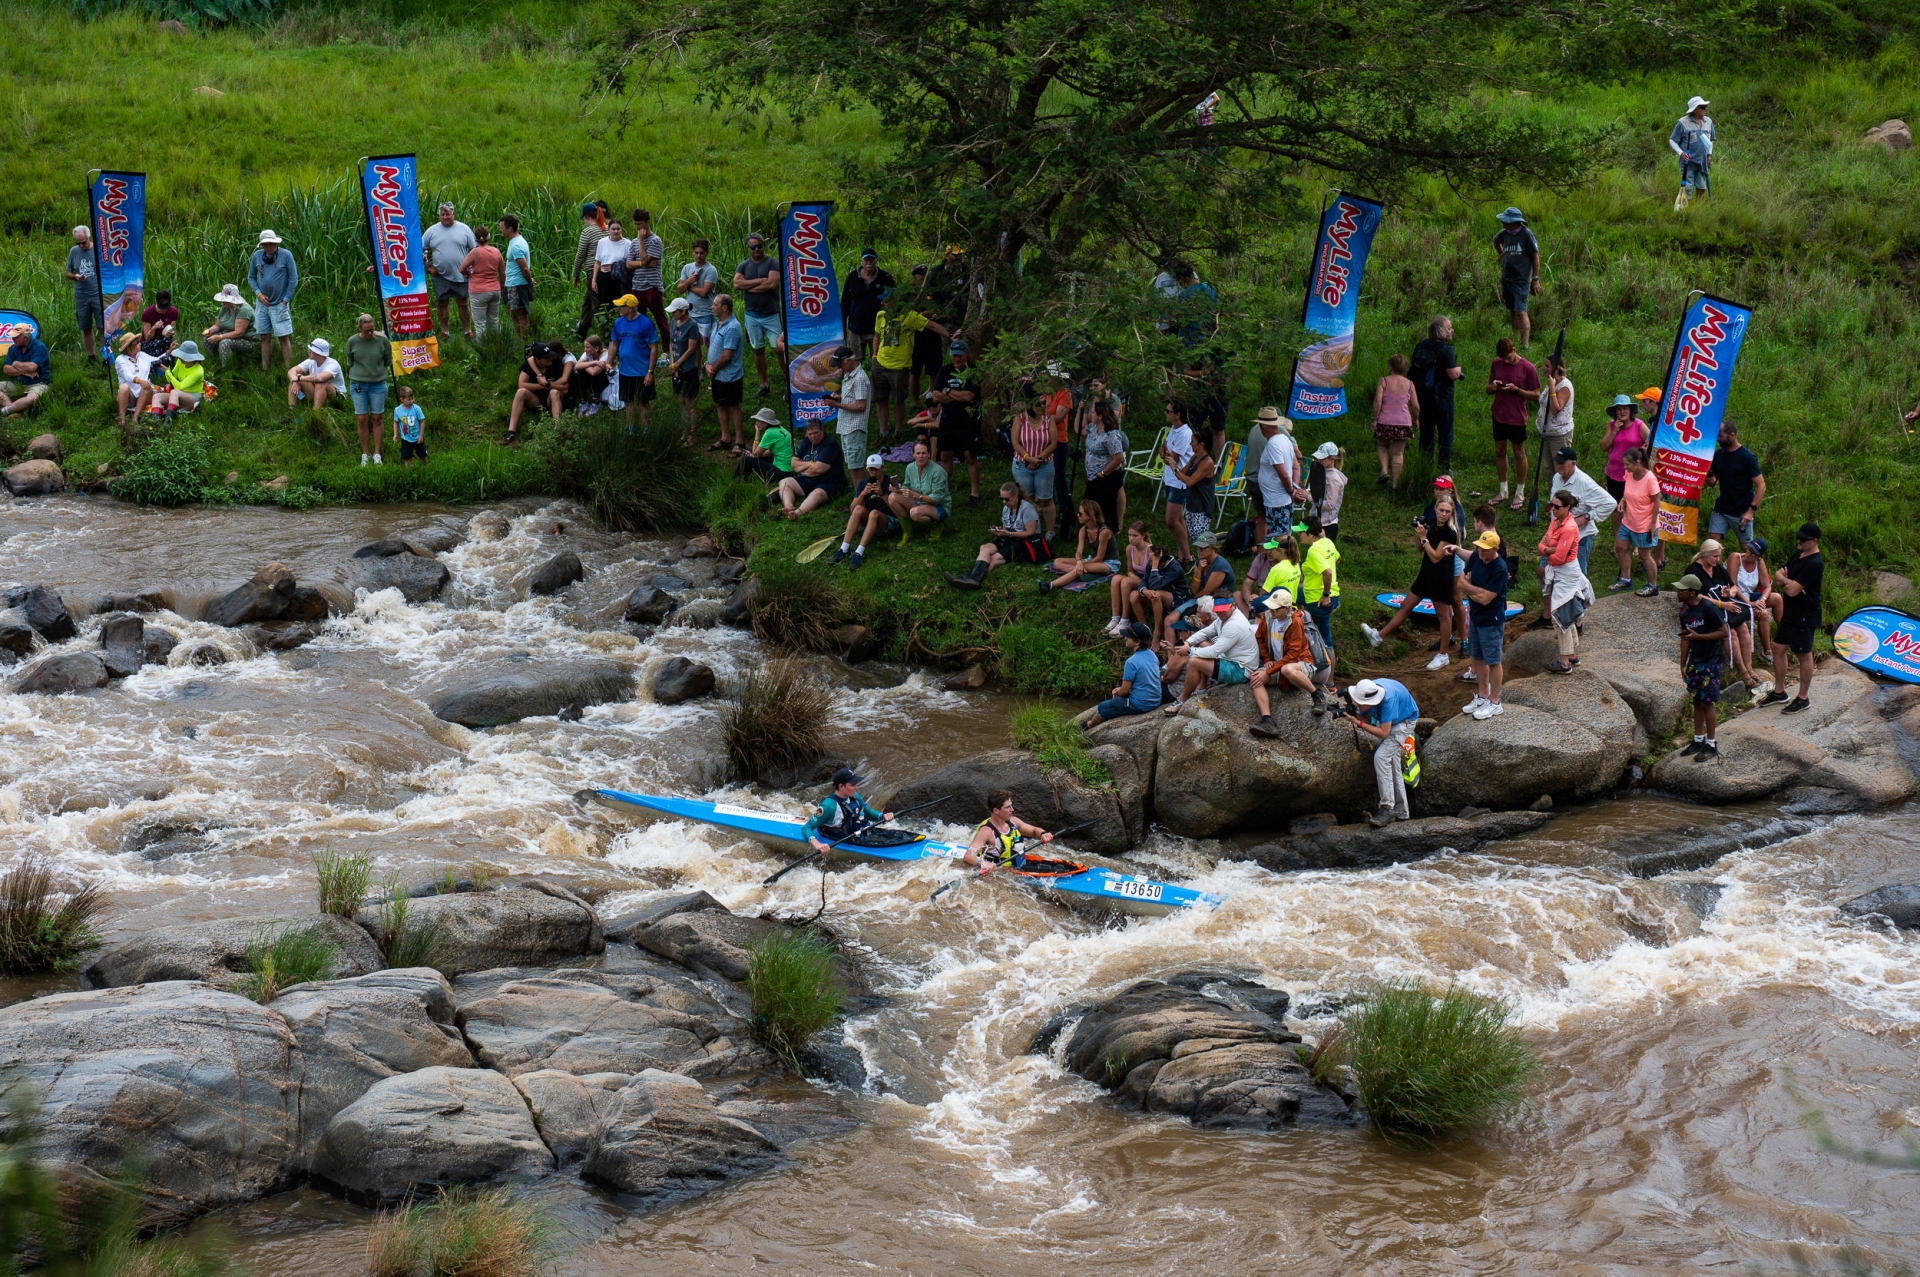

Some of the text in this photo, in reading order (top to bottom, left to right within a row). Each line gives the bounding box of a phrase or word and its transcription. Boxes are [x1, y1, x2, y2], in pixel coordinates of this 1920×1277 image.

[98, 177, 129, 267] MyLife
[375, 216, 387, 265] WHOLEGRAIN FOODS
[788, 210, 829, 317] MyLife
[1322, 201, 1362, 308] MyLife
[1315, 243, 1328, 295] WHOLEGRAIN FOODS
[788, 255, 798, 308] WHOLEGRAIN FOODS
[401, 345, 426, 358] Super
[402, 354, 432, 368] Cereal
[1668, 357, 1687, 412] WHOLEGRAIN FOODS
[798, 398, 829, 409] Insta
[1294, 401, 1341, 415] Porridge
[1669, 454, 1699, 467] 13% Protein
[1659, 520, 1685, 535] ereal
[1882, 630, 1920, 656] MyL
[1872, 654, 1903, 670] Instant
[1901, 663, 1920, 677] Porri
[1124, 881, 1161, 898] 13650
